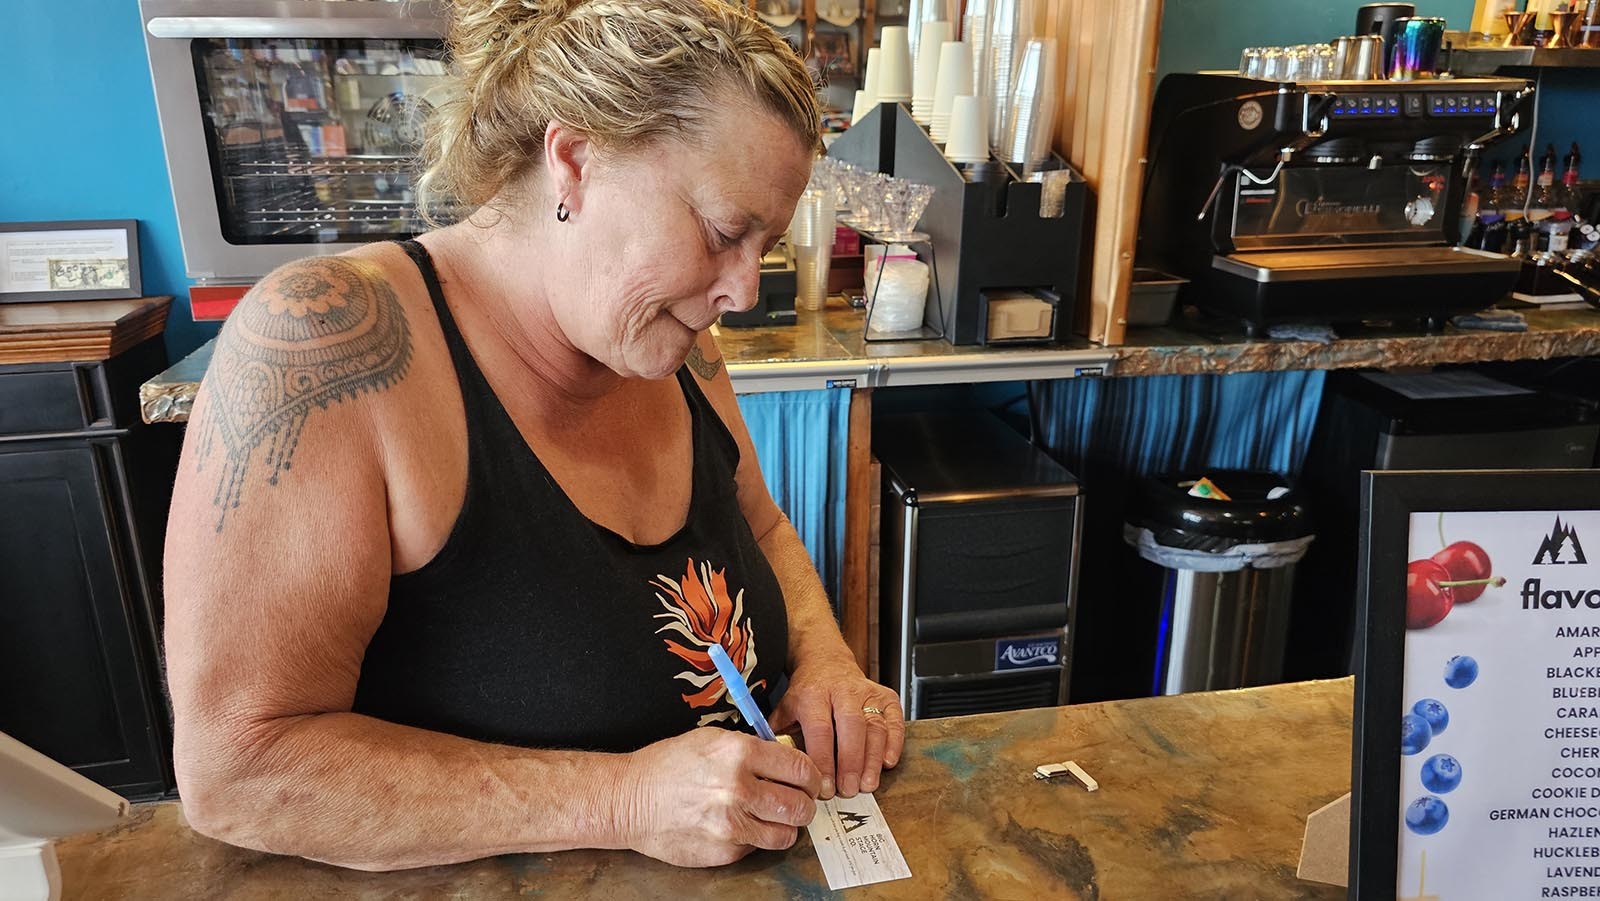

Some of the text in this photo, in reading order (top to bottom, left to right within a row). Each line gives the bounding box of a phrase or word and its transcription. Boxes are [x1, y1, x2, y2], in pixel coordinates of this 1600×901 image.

[1555, 626, 1600, 638] AMAR
[1000, 644, 1058, 665] AVANTCO
[1573, 647, 1600, 658] APP
[1552, 687, 1600, 699] BLUEB
[1556, 707, 1600, 719] CARA
[1544, 727, 1600, 739] CHEESE
[1560, 747, 1600, 758] CHER
[1532, 787, 1587, 799] COOKIE
[1489, 807, 1600, 820] GERMAN CHOC
[855, 837, 868, 854] STAGE
[870, 835, 881, 851] HORN
[863, 835, 880, 865] MOUNTAIN
[1533, 847, 1600, 858] HUCKLEB
